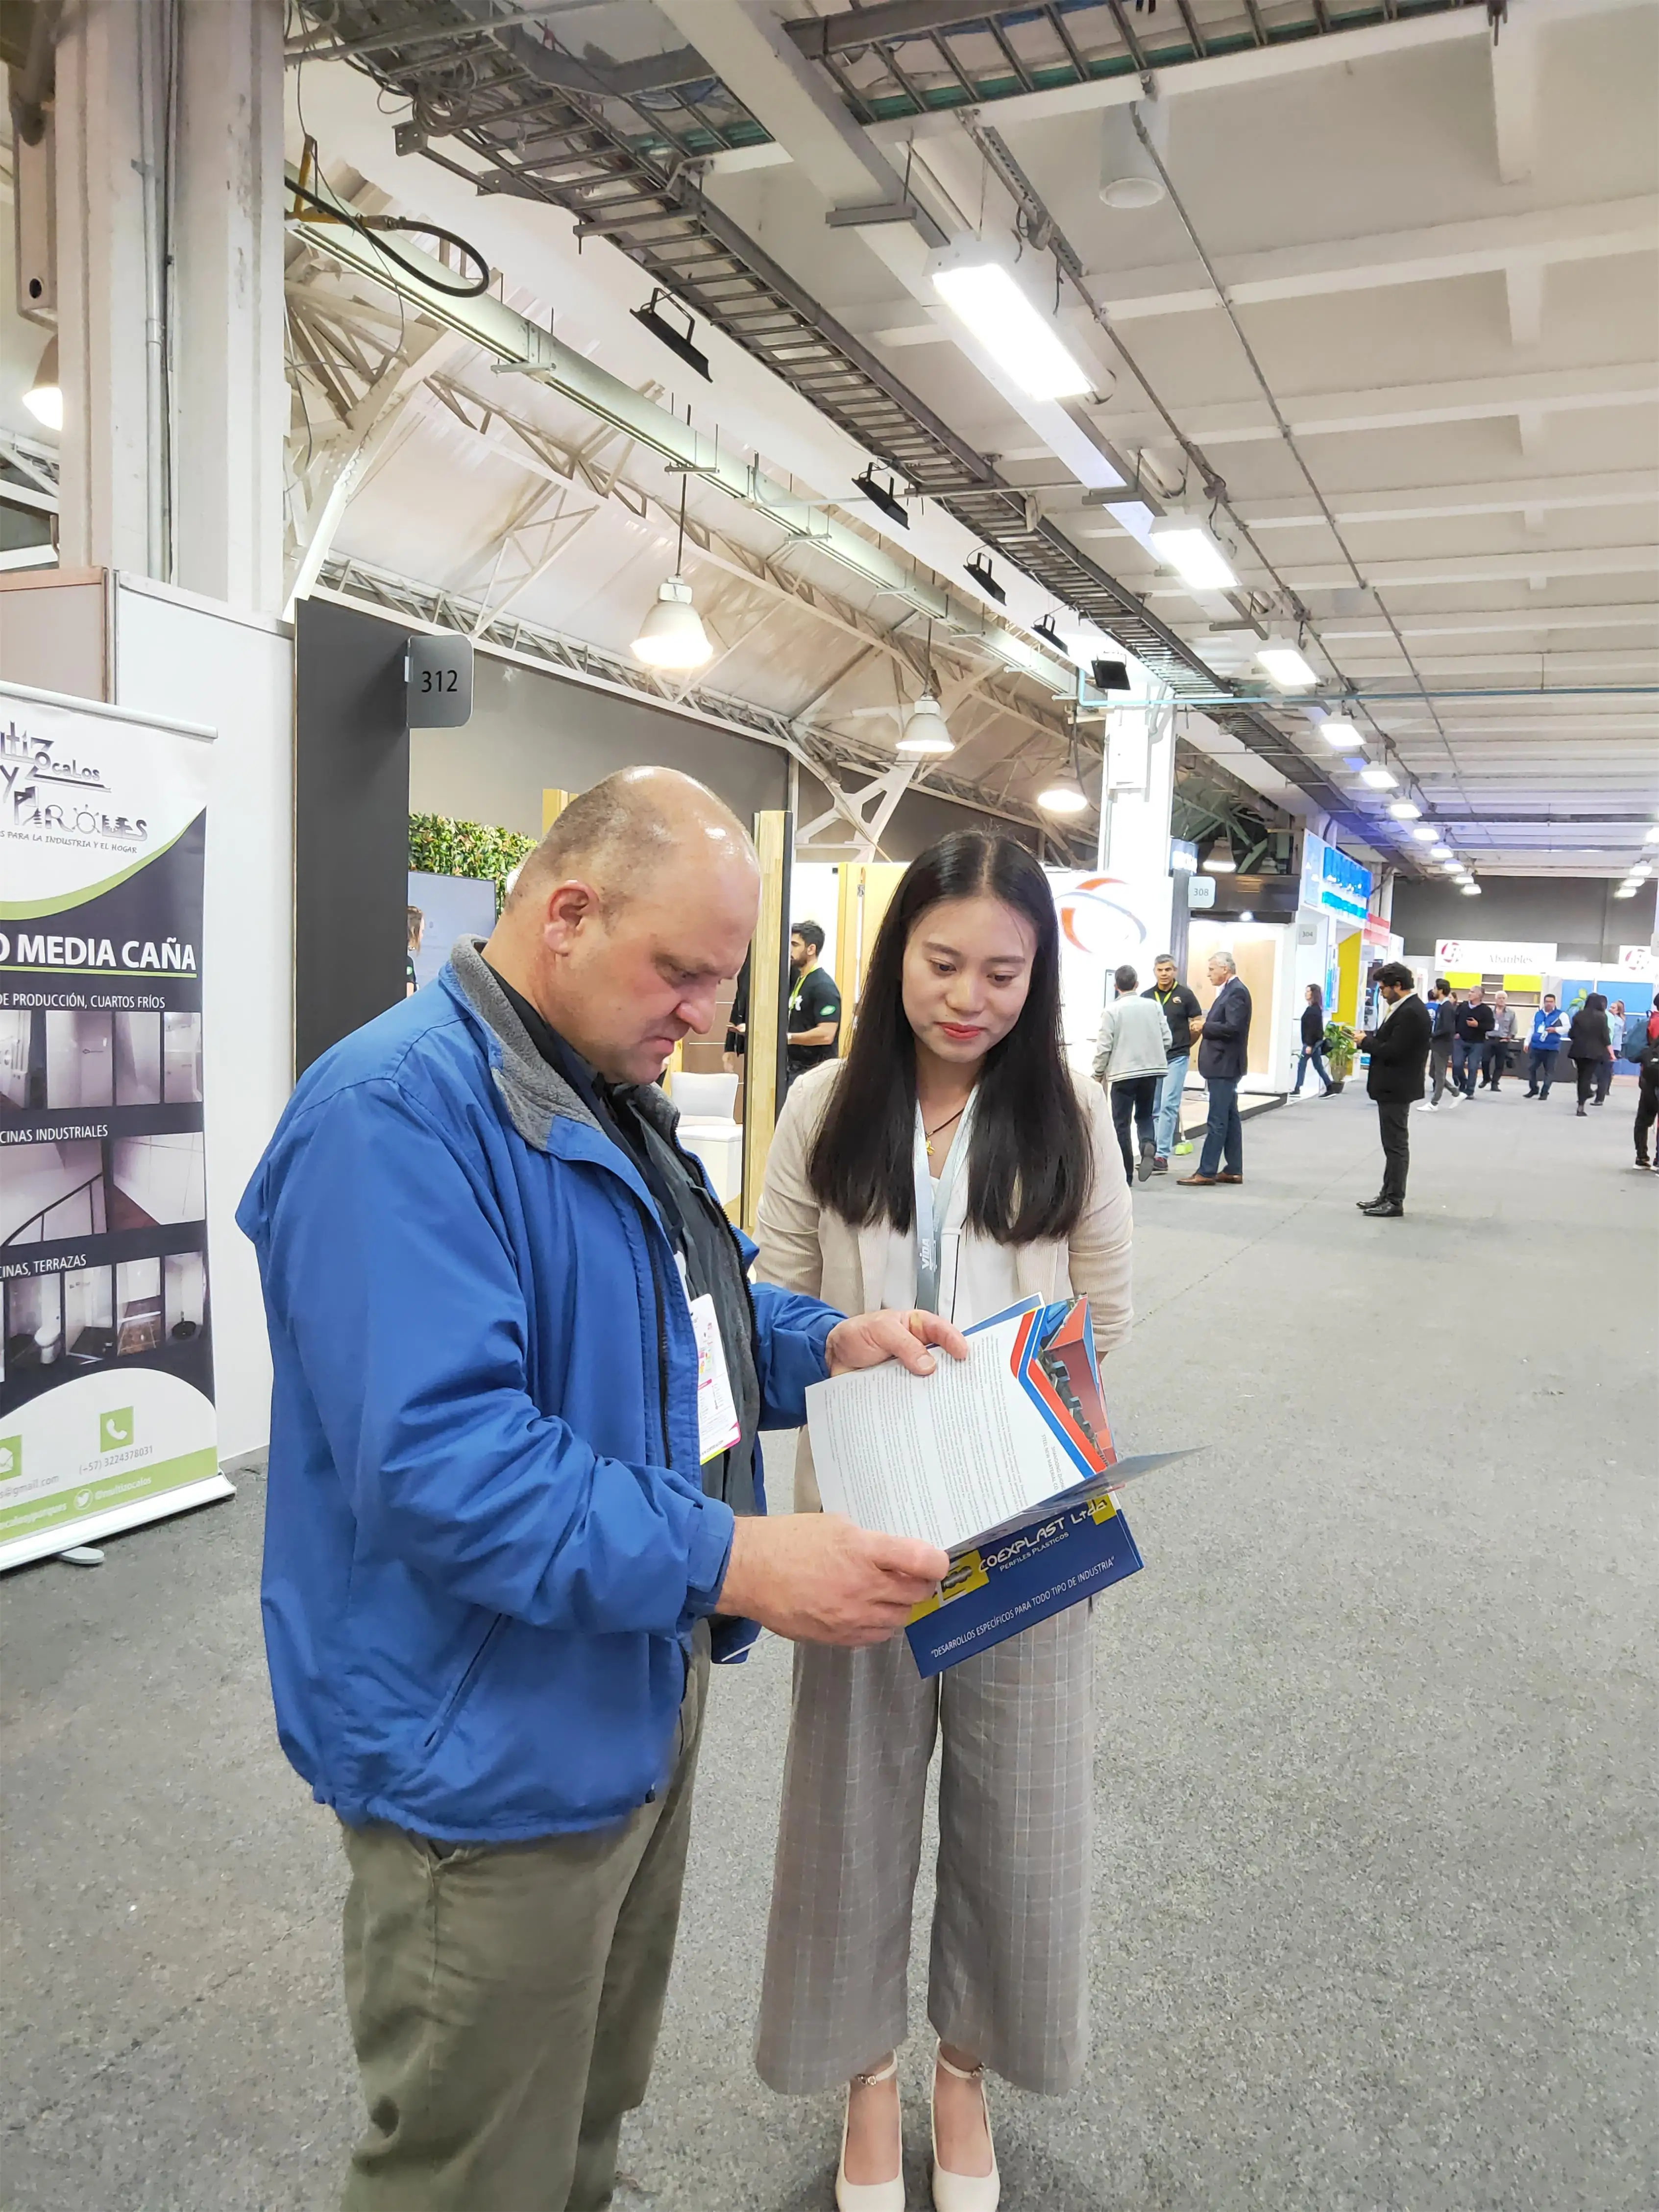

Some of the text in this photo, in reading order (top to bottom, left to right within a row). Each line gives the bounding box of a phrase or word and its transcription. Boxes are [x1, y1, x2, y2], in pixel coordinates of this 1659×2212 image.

[421, 670, 458, 692] 312
[7, 831, 29, 840] PARA
[45, 836, 91, 848] INDUSTRIA
[111, 844, 137, 853] HOGAR
[17, 934, 117, 967] MEDIA
[122, 937, 196, 970] CAÑA
[13, 993, 88, 1009] PRODUCCIÓN,
[91, 995, 135, 1008] CUARTOS
[138, 994, 165, 1009] FRÍOS
[0, 1125, 108, 1143] CINAS INDUSTRIALES
[0, 1254, 87, 1279] INAS, TERRAZAS
[104, 1445, 153, 1467] 3224378031
[978, 1517, 1065, 1572] COEXPLAST
[1000, 1532, 1069, 1572] PERFILES PLASTICOS
[977, 1610, 1014, 1635] ESPECÍFICOS
[1015, 1601, 1031, 1616] PARA
[1031, 1591, 1050, 1607] TODO
[1051, 1583, 1067, 1599] TIPO
[1069, 1578, 1077, 1589] DE
